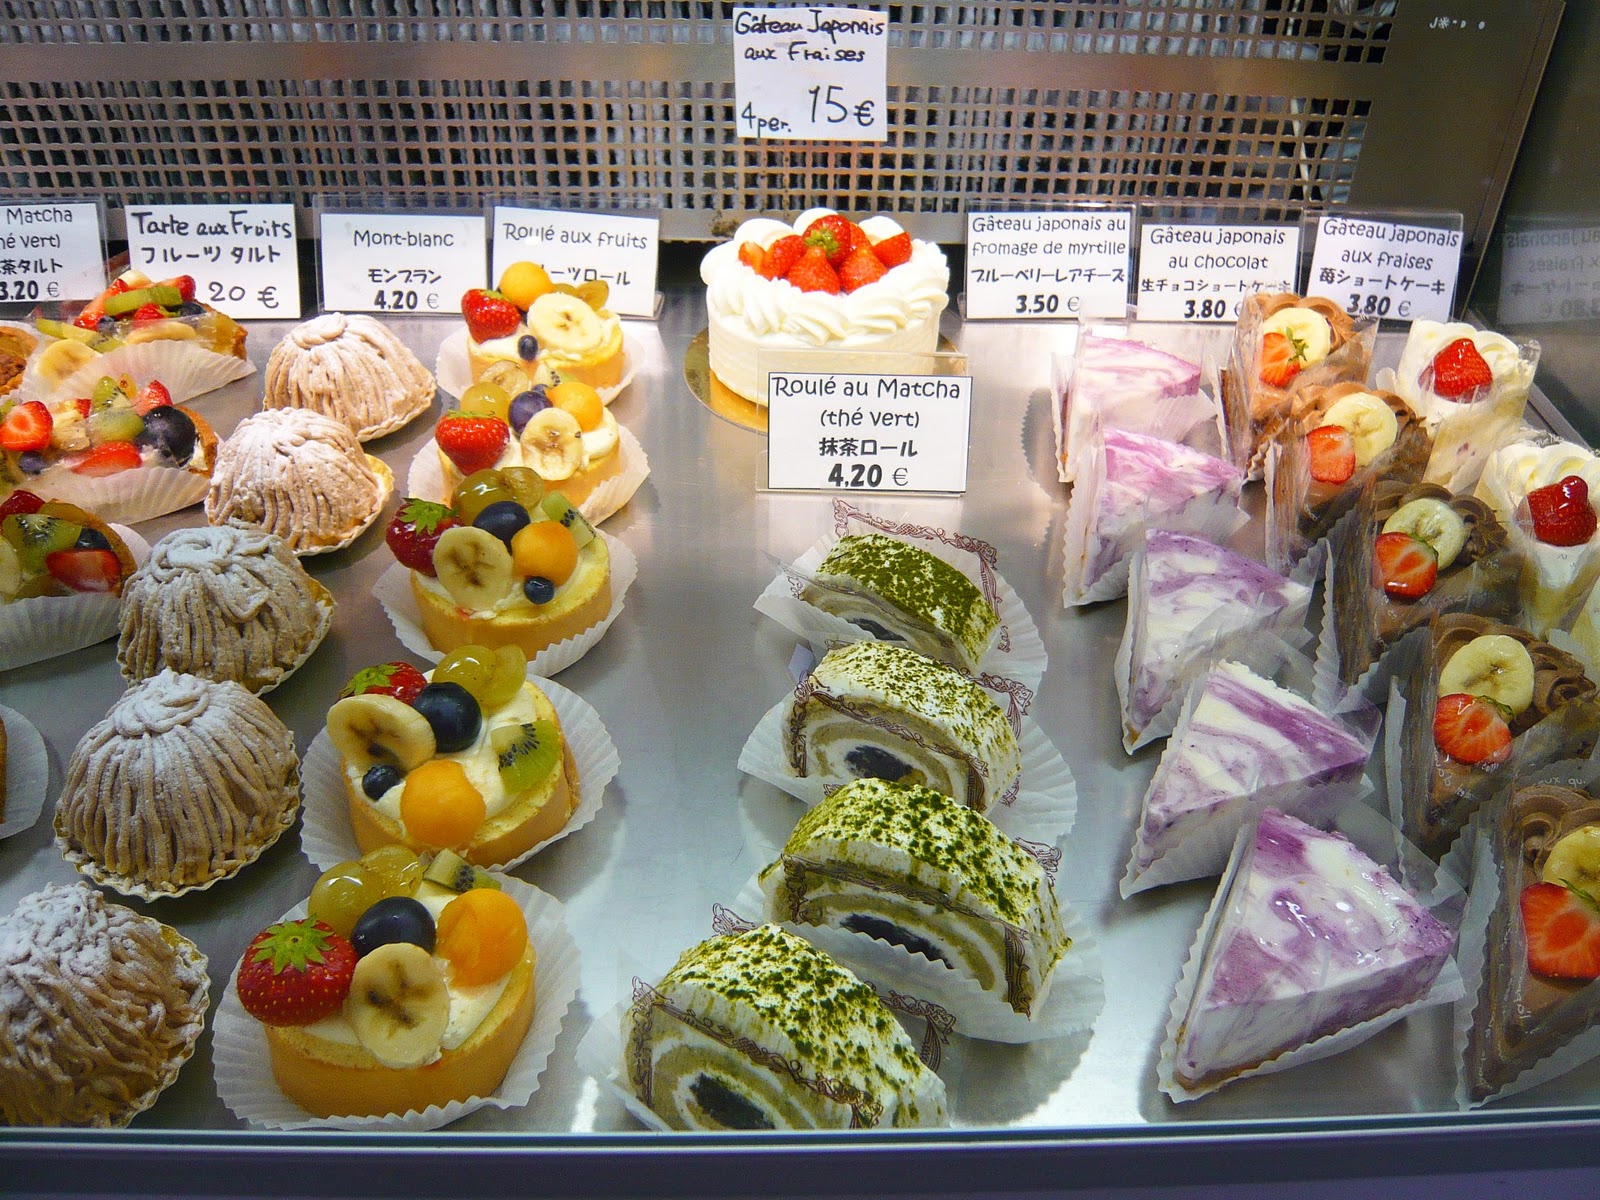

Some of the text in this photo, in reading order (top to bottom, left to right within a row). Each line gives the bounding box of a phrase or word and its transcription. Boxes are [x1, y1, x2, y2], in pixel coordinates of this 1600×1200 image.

[735, 9, 885, 44] Gâteau Japonais
[743, 40, 866, 63] aux Fraises
[5, 206, 74, 226] Matcha
[131, 211, 190, 235] Tarte
[971, 214, 1127, 233] Gâteau japonais au
[19, 233, 62, 249] vert)
[353, 229, 455, 249] Mont-blanc
[559, 230, 592, 244] aux
[597, 231, 649, 250] fruits
[1150, 225, 1287, 247] Gâteau japonais
[1322, 217, 1461, 249] Gâteau japonais
[971, 240, 1127, 257] fromage de myrtille
[0, 257, 64, 276] 茶タルト
[1167, 253, 1269, 271] au chocolat
[1340, 248, 1434, 272] aux fraises
[367, 268, 443, 285] モンブラン
[970, 267, 1126, 284] ブルーベリーレアチーズ
[425, 291, 441, 310] €
[1066, 295, 1081, 313] €
[1397, 300, 1413, 318] €
[771, 375, 962, 400] Roulé au Matcha
[819, 407, 921, 429] (thé vert)
[818, 436, 919, 458] 抹茶ロール
[891, 466, 910, 487] €
